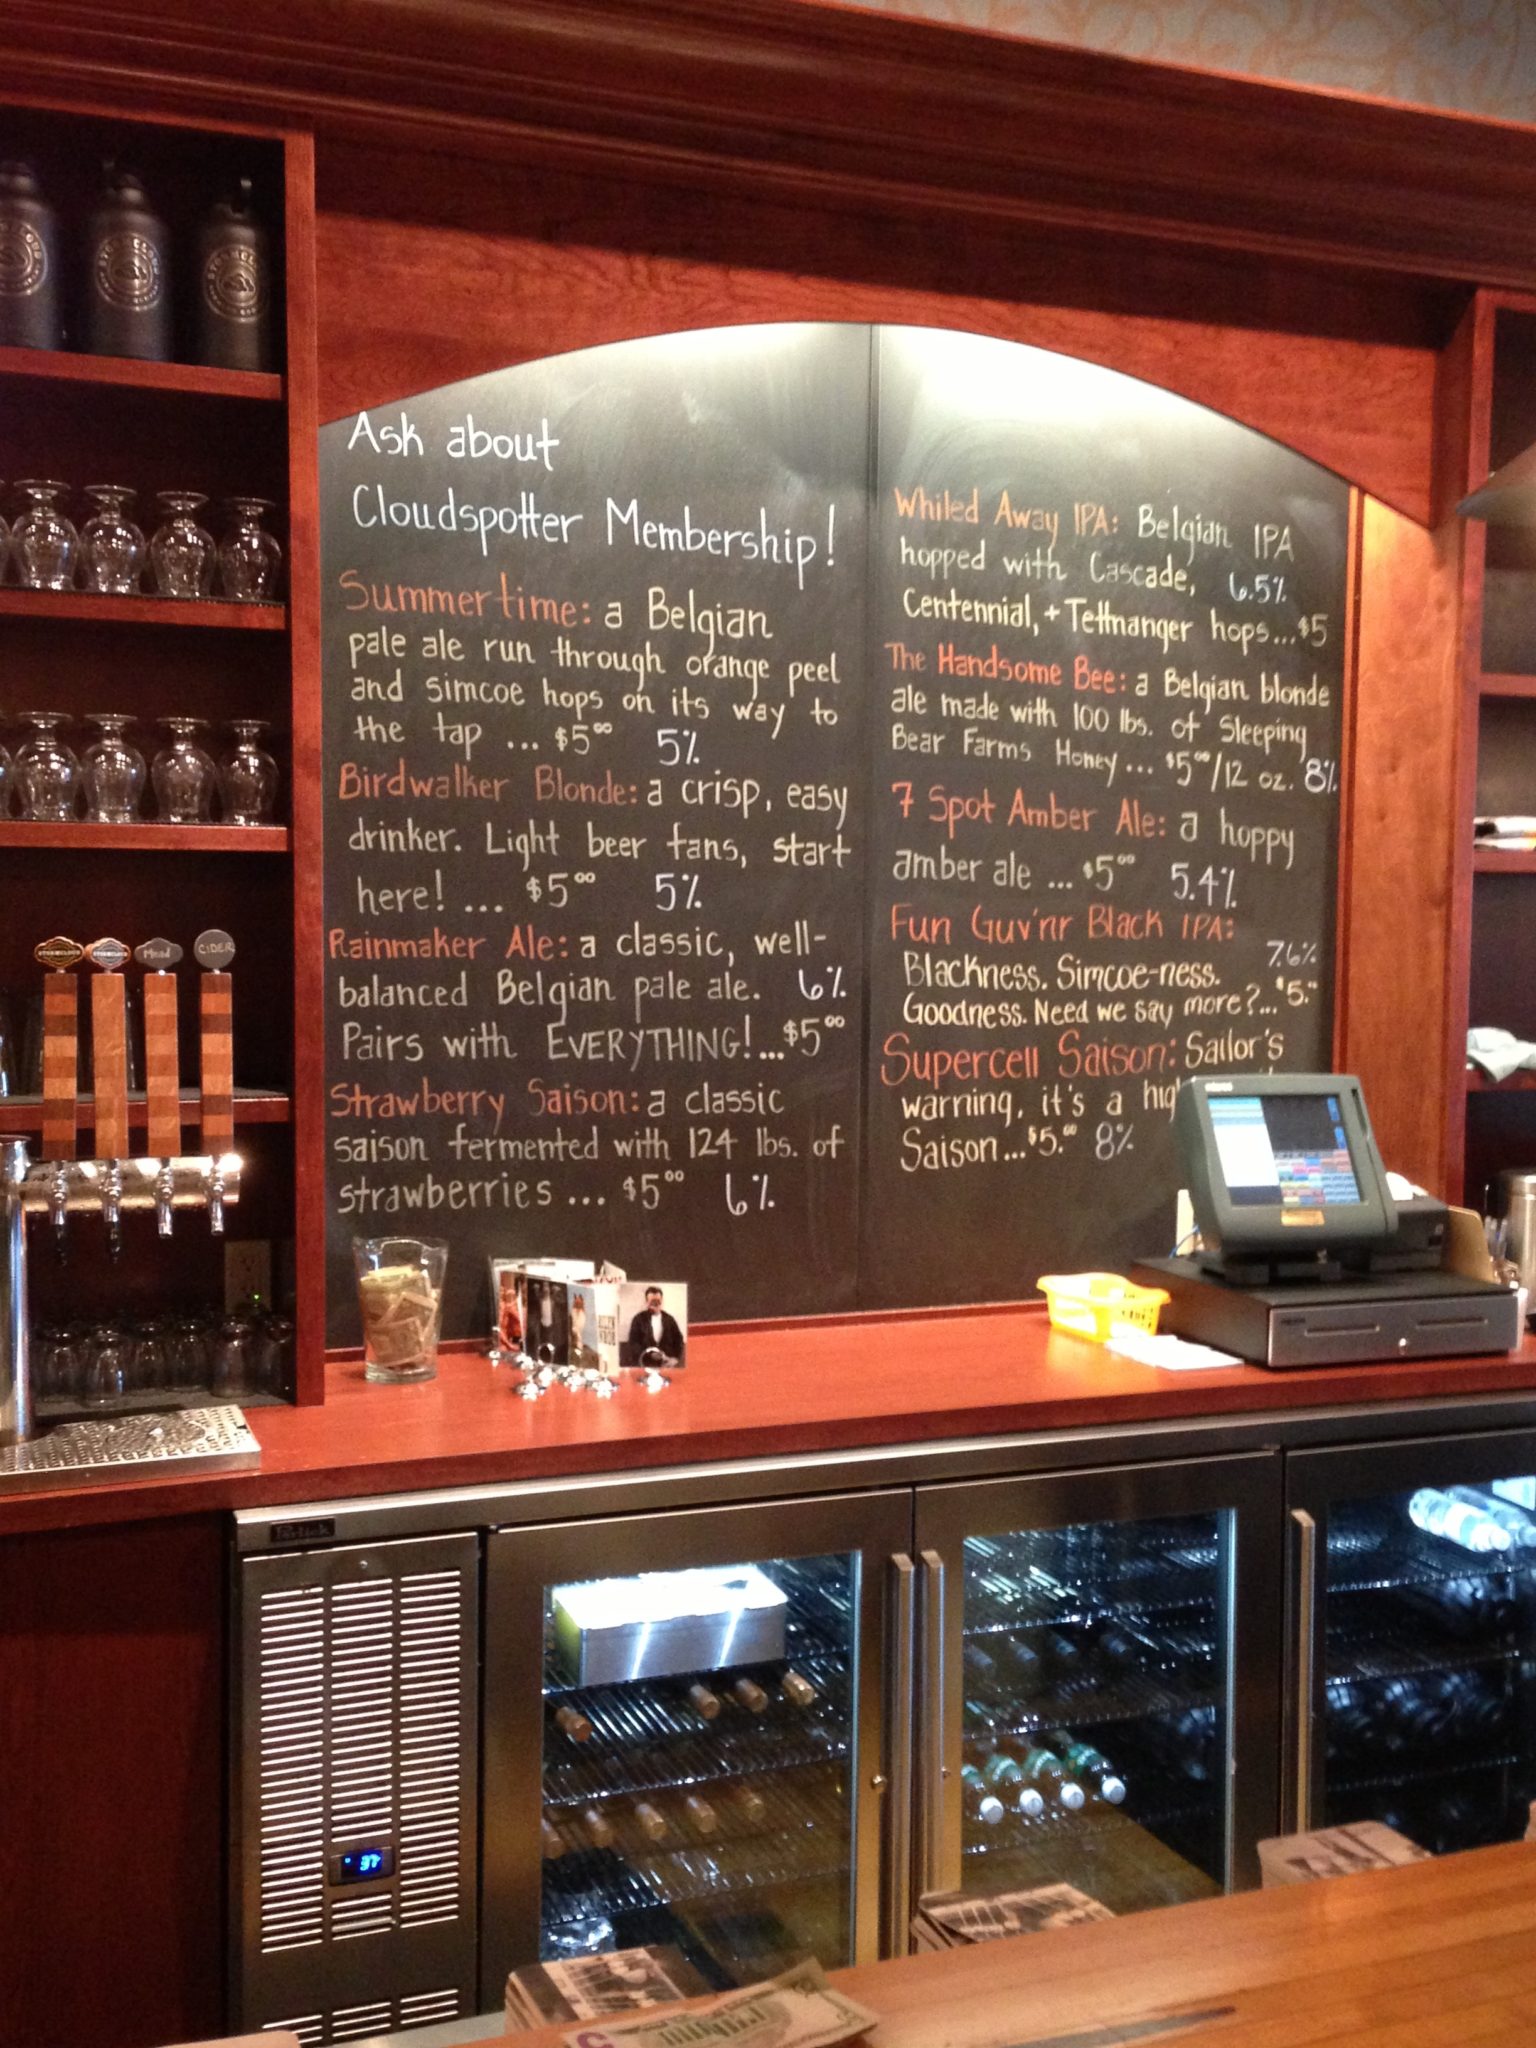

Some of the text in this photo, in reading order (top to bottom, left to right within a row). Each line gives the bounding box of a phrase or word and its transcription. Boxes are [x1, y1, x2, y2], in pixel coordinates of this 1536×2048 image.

[348, 411, 560, 471] Ask about
[353, 484, 834, 590] Cloudspotter Membership!
[893, 487, 1294, 567] Whiled Away IPA: Belgian IPA
[901, 535, 1287, 604] hopped with Cascade, 6.5%
[603, 601, 623, 629] a
[648, 586, 773, 657] Belgian
[903, 587, 1039, 637] Centennial,
[1044, 604, 1060, 621] +
[1064, 597, 1194, 655] Tettnanger
[349, 625, 841, 700] pale ale run through orange peel
[884, 642, 1330, 715] The Handsome Bee: a Belgian blonde
[350, 668, 838, 740] and simcoe hops on its way to
[891, 683, 1307, 764] ale made with 100 lbs. of Sleeping
[354, 715, 405, 743] the
[432, 711, 482, 760] tap
[657, 728, 700, 766] 5%
[892, 723, 945, 754] Bear
[964, 727, 1031, 762] Farms
[1056, 738, 1119, 788] Honey
[1258, 771, 1294, 791] oz.
[1304, 758, 1338, 794] 8%
[339, 758, 848, 831] Birdwalker Blonde: a crisp, easy
[349, 816, 462, 852] drinker.
[486, 818, 560, 872] Light
[586, 821, 647, 859] beer
[773, 832, 852, 868] start
[891, 781, 1294, 871] 7 Spot Amber Ale: a hoppy
[357, 869, 444, 916] here!
[655, 873, 701, 911] 5%
[893, 844, 983, 882] amber
[993, 850, 1032, 890] ale
[1171, 862, 1237, 909] 5.4%
[199, 942, 235, 955] CIDER
[329, 920, 827, 967] Rainmaker Ale: a classic, well-
[891, 903, 1235, 945] Fun Guv'nr Black IPA:
[339, 966, 847, 1025] balanced Belgian pale ale. 6%
[904, 940, 1318, 992] Blackness. Simcoe-ness. 7.6%
[903, 991, 1027, 1029] Goodness.
[1034, 997, 1089, 1026] Need
[1097, 1001, 1127, 1023] we
[1135, 999, 1173, 1029] say
[343, 1021, 424, 1062] Pairs
[443, 1021, 518, 1060] with
[880, 1027, 1284, 1090] Supercell Saison: Sailor's
[330, 1077, 785, 1136] Strawberry Saison: a classic
[901, 1087, 1024, 1129] warning,
[1042, 1083, 1085, 1118] it's
[1106, 1091, 1122, 1116] a
[334, 1122, 845, 1163] saison fermented with 124 lbs. of
[1096, 1121, 1134, 1160] 8%
[337, 1172, 552, 1213] strawberries
[726, 1173, 775, 1216] 6%
